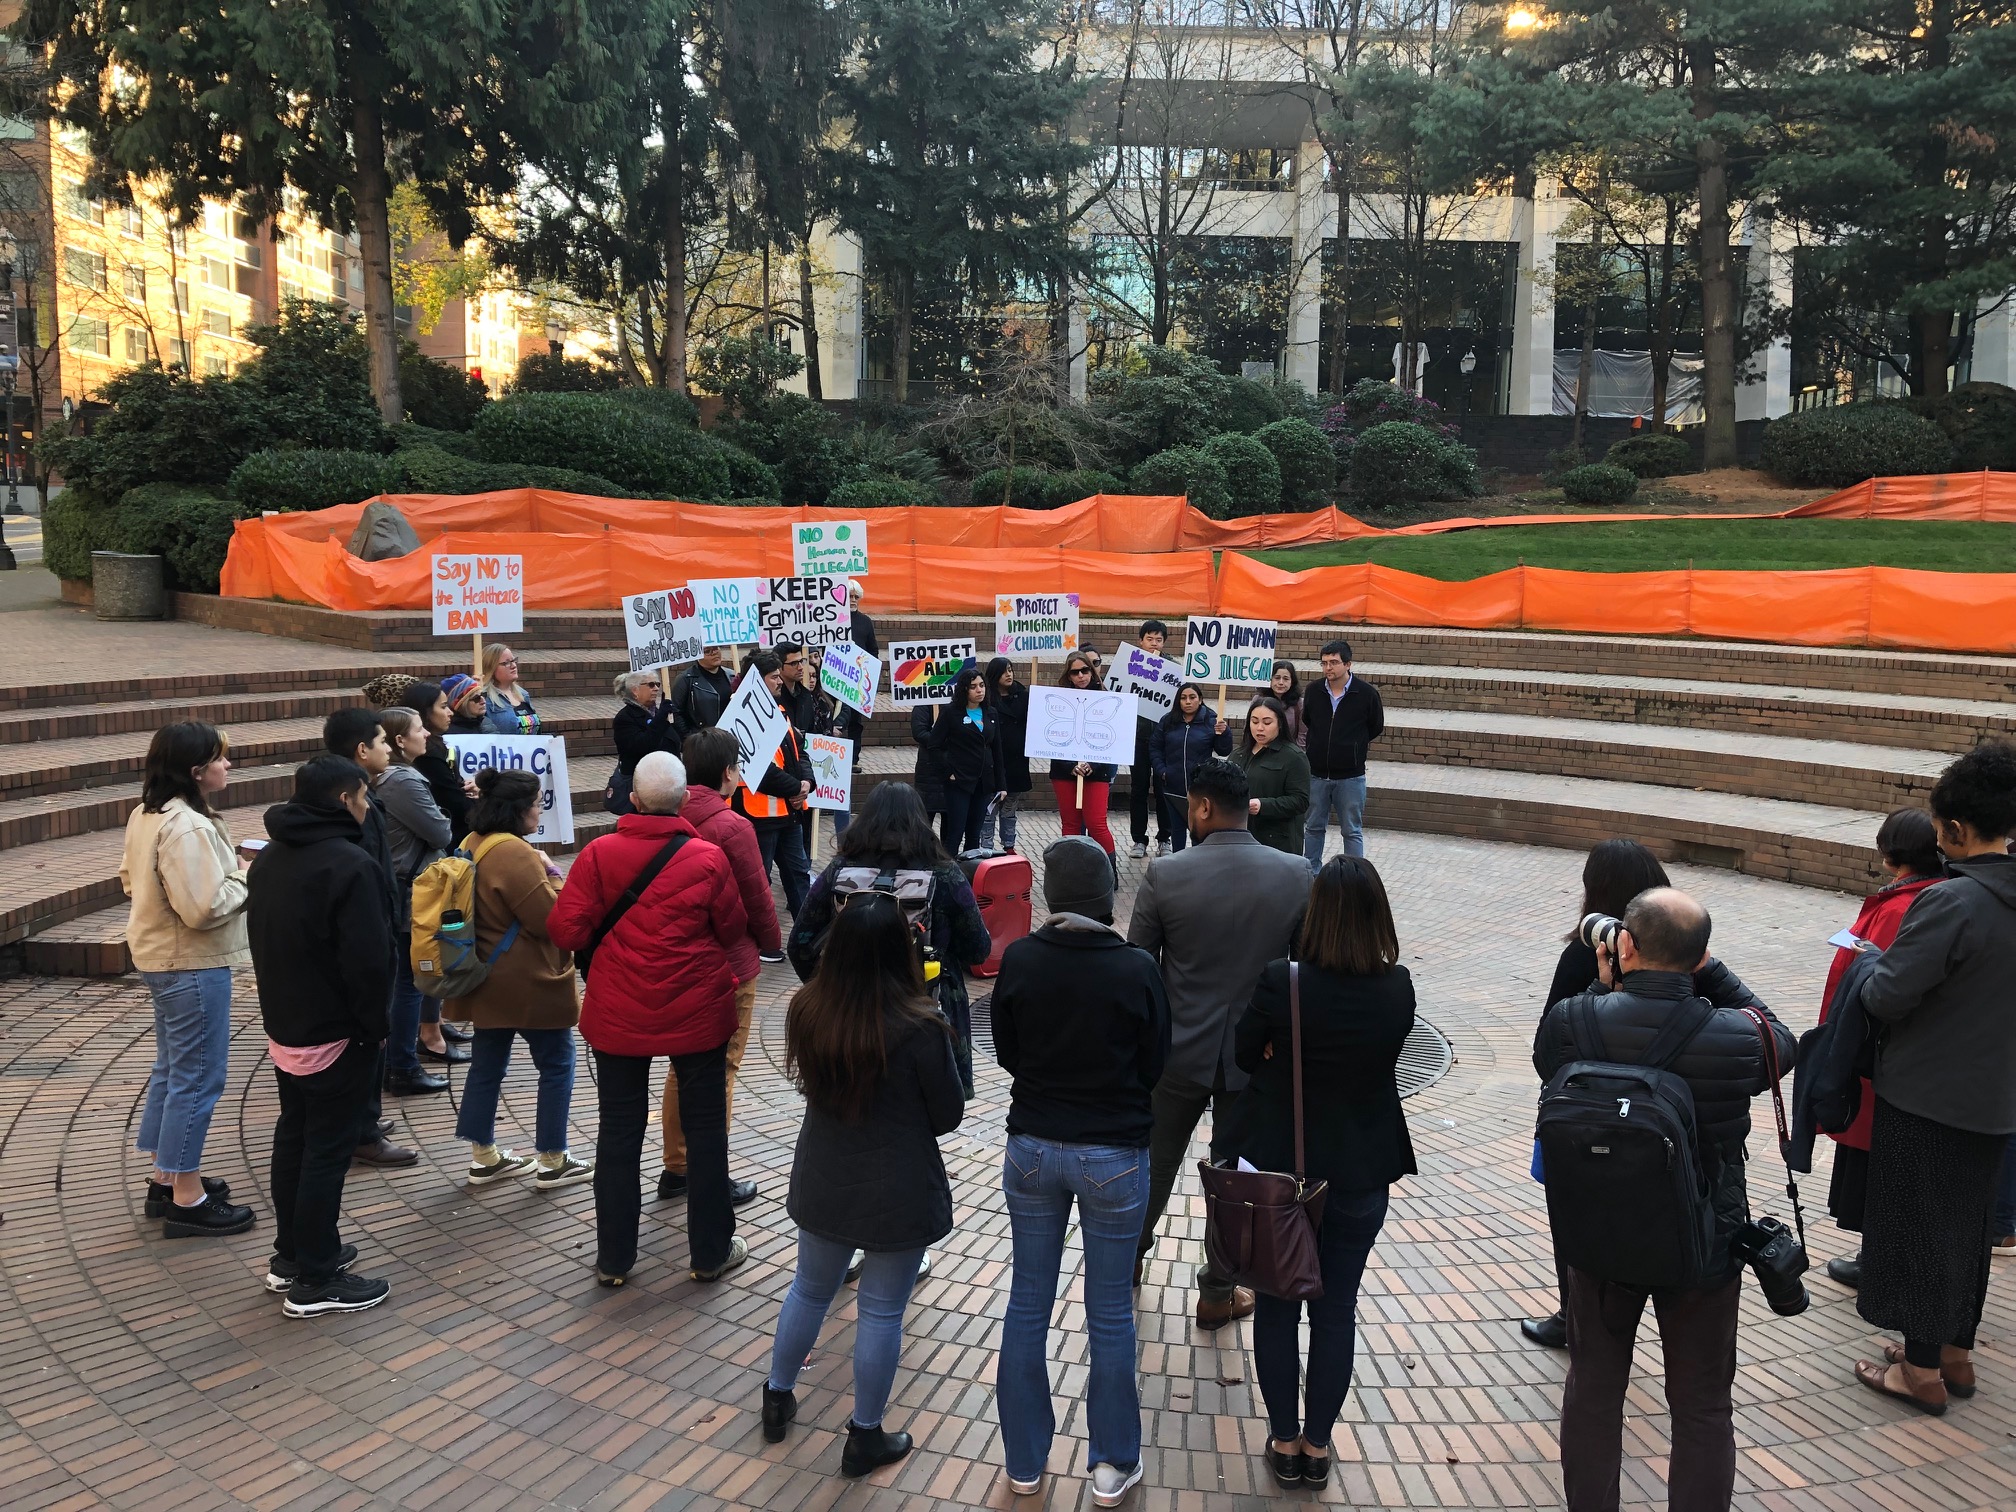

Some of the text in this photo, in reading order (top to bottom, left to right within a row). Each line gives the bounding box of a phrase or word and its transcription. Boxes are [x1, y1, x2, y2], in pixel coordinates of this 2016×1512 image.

[798, 527, 823, 544] NO
[436, 557, 520, 587] Say NO to
[435, 588, 453, 607] the
[713, 584, 740, 605] NO
[769, 577, 833, 602] KEEP
[633, 588, 696, 628] SAY NO
[699, 603, 758, 623] HUMAN IS
[758, 602, 837, 627] Families
[1015, 597, 1059, 617] PROTECT
[447, 607, 488, 631] BAN
[1008, 617, 1068, 633] IMMIGRANT
[654, 621, 674, 641] TO
[703, 620, 758, 644] ILLEGA
[763, 624, 852, 646] Together
[1187, 620, 1276, 650] NO HUMAN
[894, 643, 972, 661] PROTECT
[1014, 634, 1062, 652] CHILDREN
[824, 651, 860, 683] FAMILIES
[924, 661, 955, 676] ALL
[1185, 652, 1211, 679] IS
[821, 669, 860, 704] TOGETHER
[1130, 682, 1171, 708] Primero
[812, 737, 846, 760] BRIDGES
[815, 784, 846, 804] WALLS
[1774, 1096, 1785, 1132] Canon
